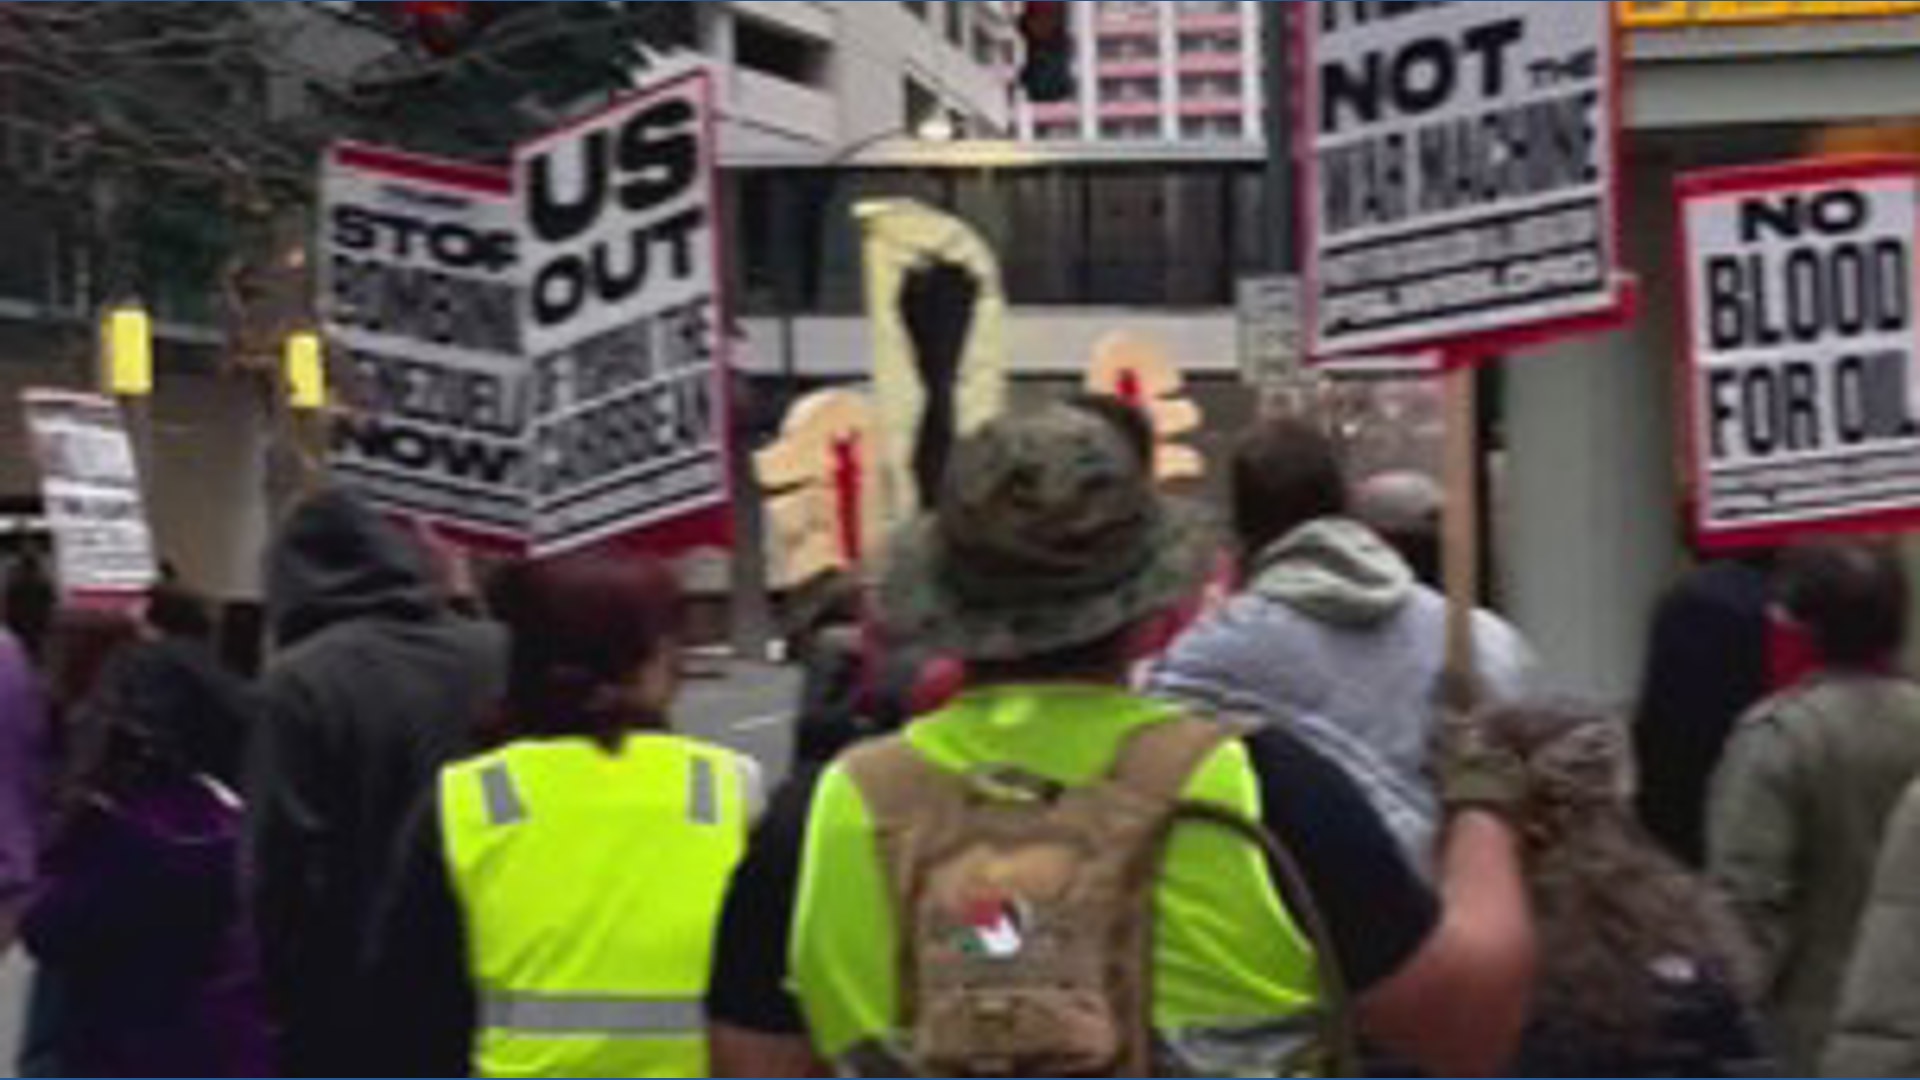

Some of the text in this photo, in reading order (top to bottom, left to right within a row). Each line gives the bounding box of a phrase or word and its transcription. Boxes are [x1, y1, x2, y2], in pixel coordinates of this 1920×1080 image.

[1321, 18, 1522, 131] NOT
[528, 98, 697, 242] US
[1741, 189, 1866, 242] NO
[533, 206, 704, 325] OUT
[1707, 239, 1905, 351] BLOOD
[330, 418, 520, 483] NOW
[1709, 362, 1819, 457] FOR
